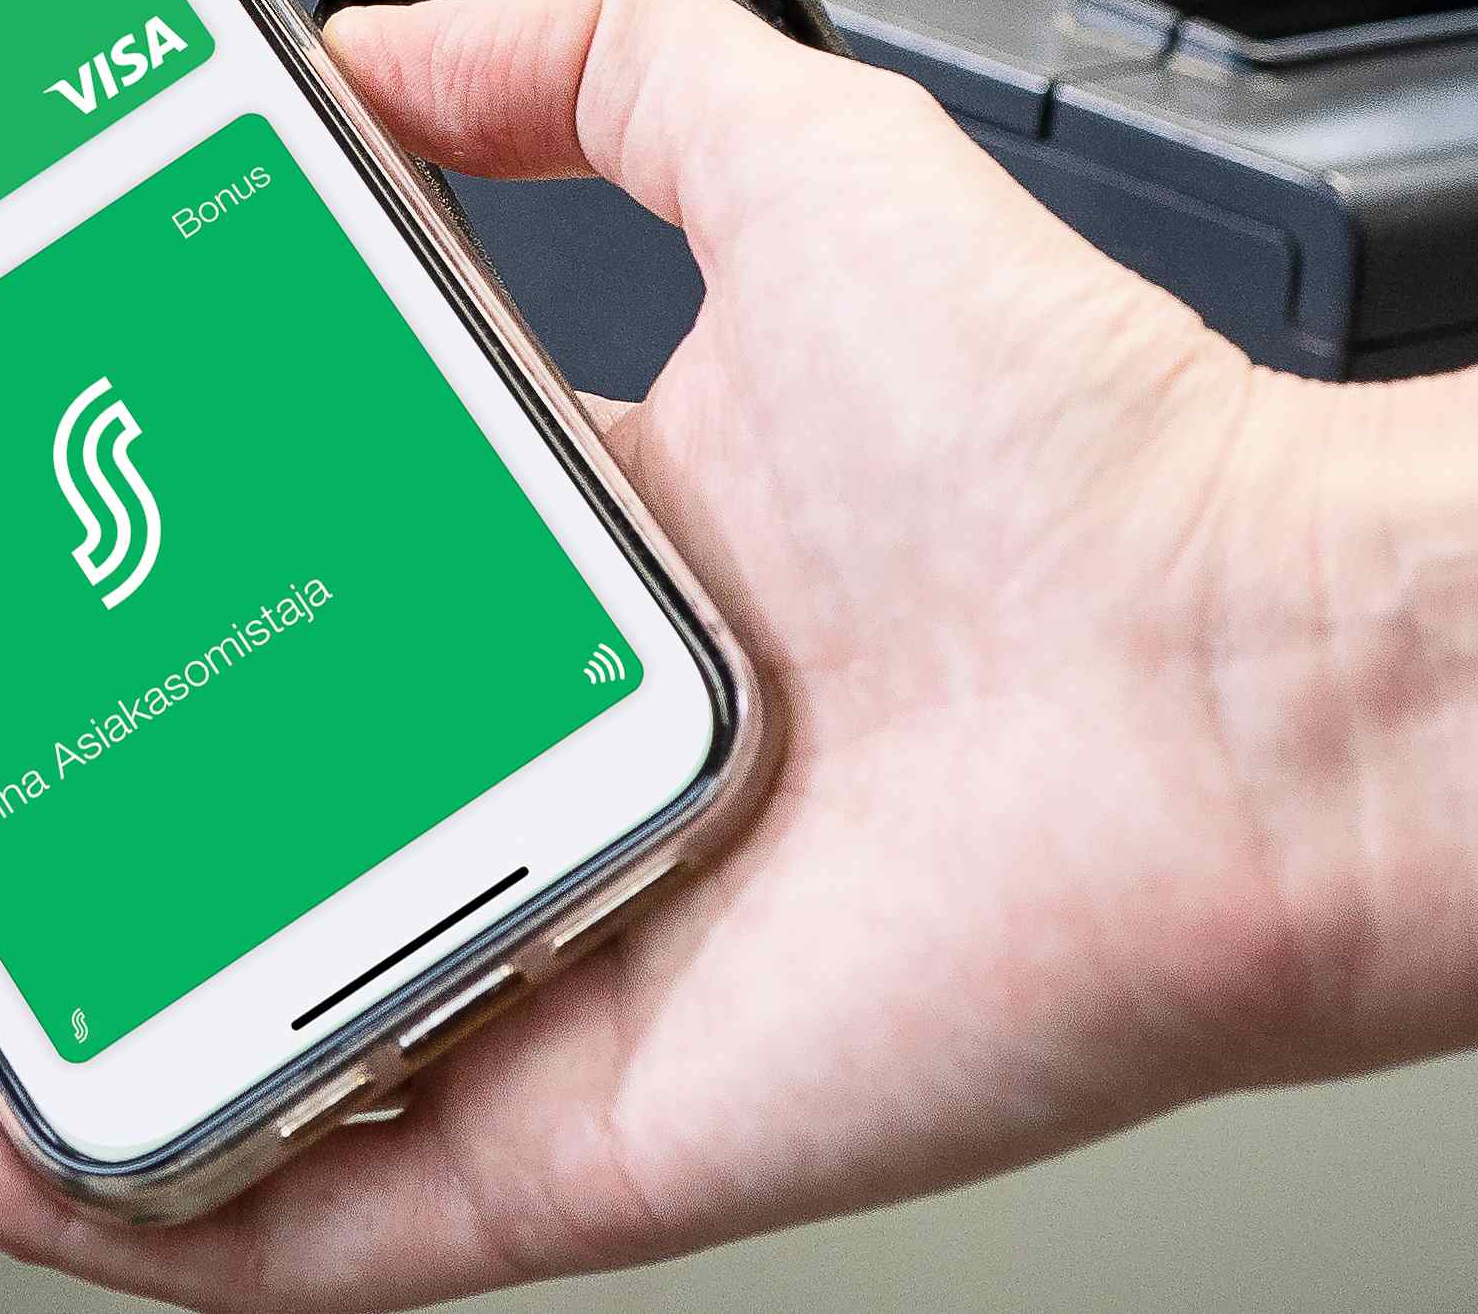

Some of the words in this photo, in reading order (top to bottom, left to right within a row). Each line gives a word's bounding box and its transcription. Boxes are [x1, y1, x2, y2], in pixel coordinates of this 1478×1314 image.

[42, 15, 189, 115] VISA
[171, 161, 271, 239] Bonus
[54, 578, 333, 780] Asiakasomistaja
